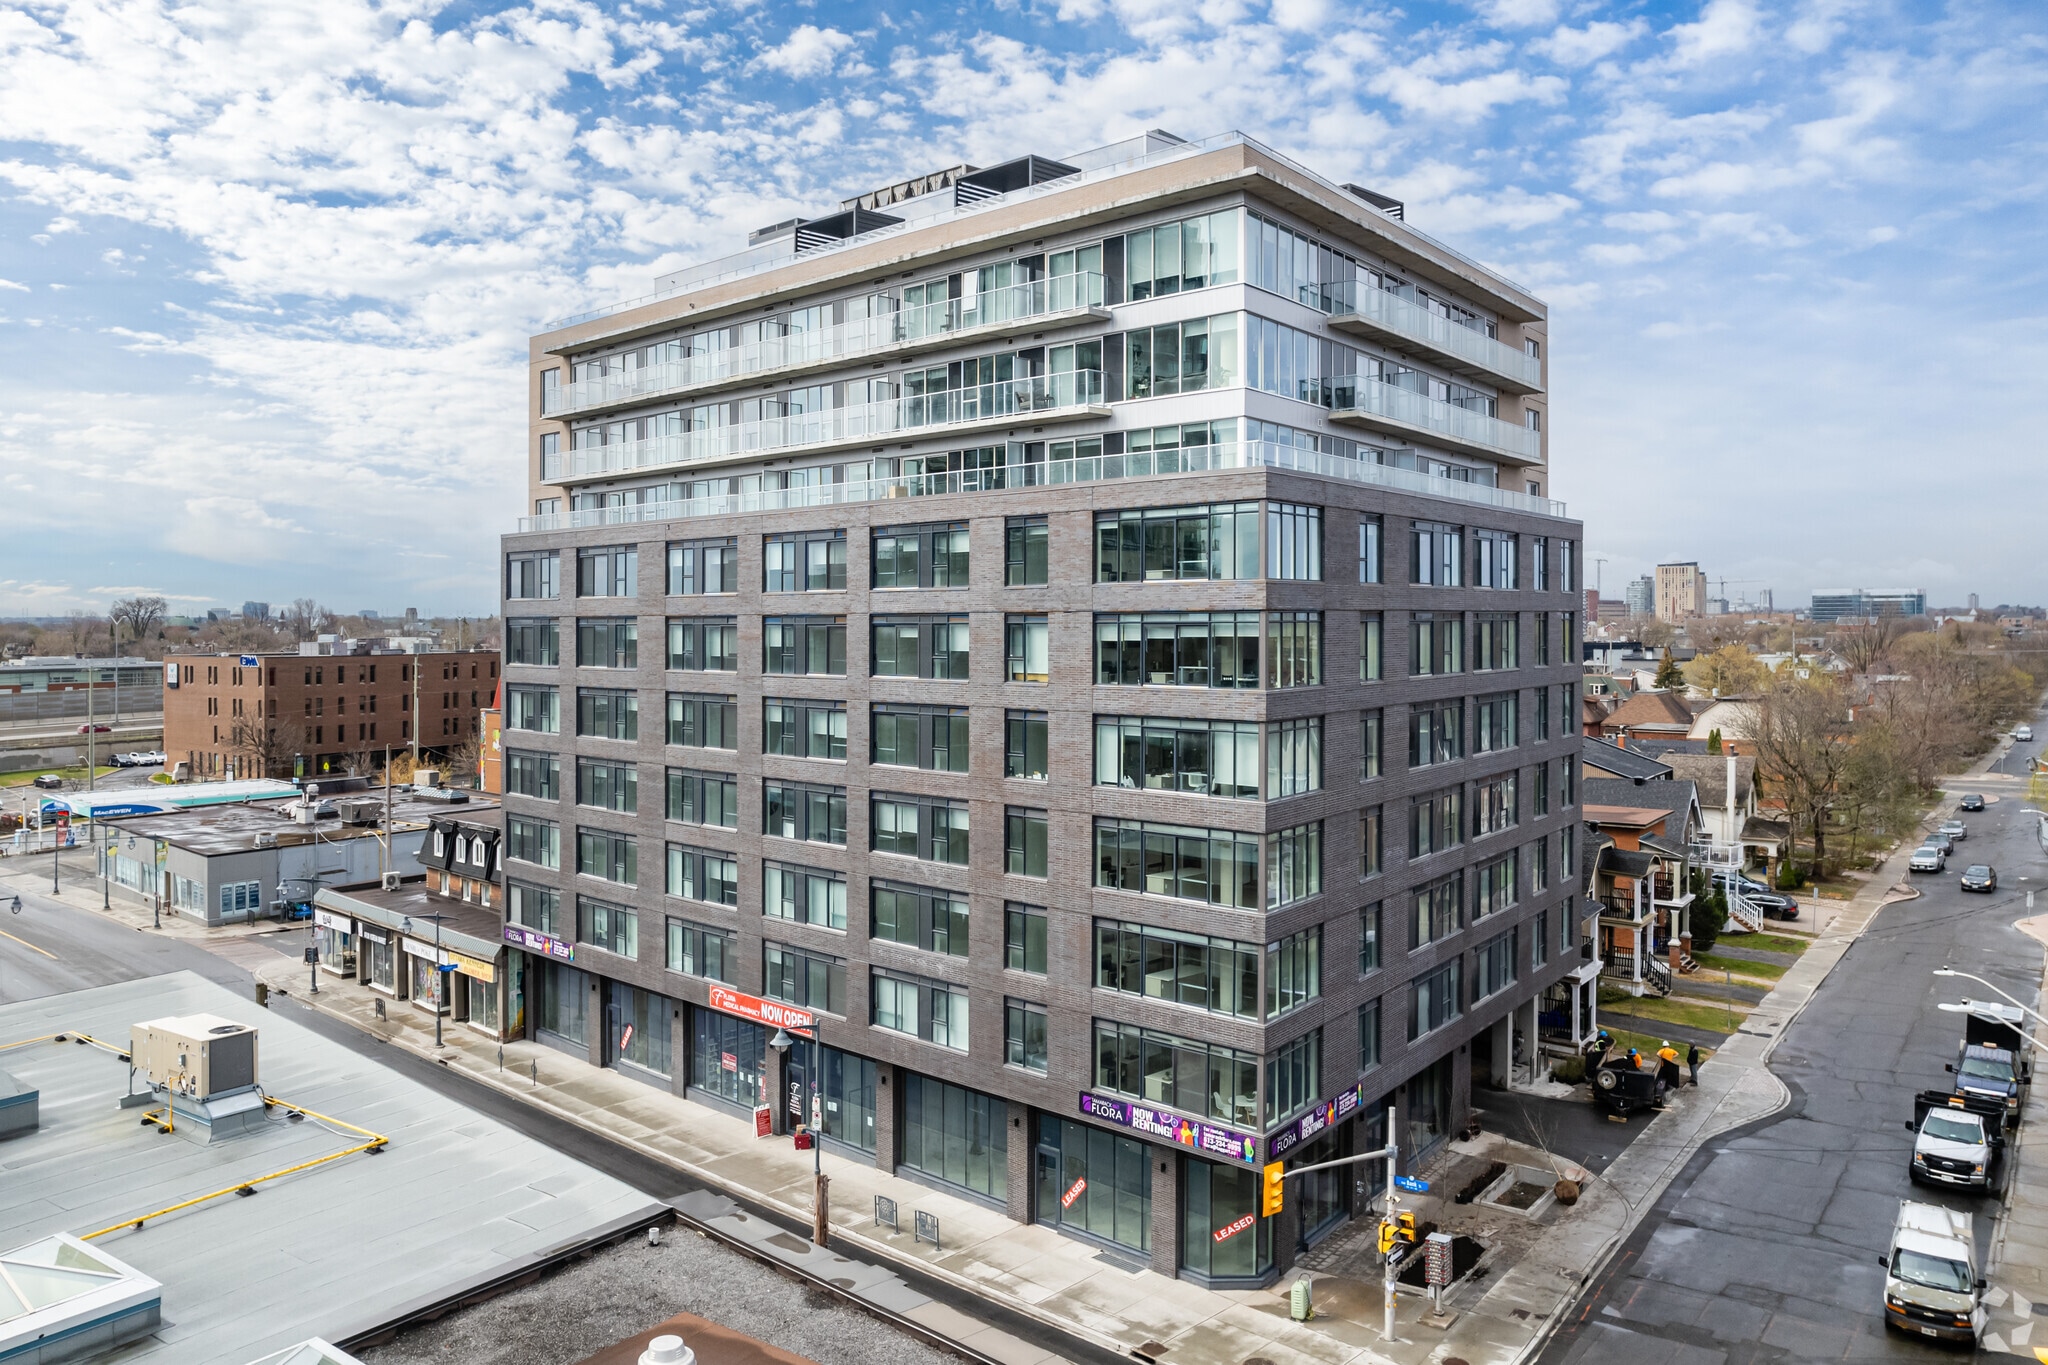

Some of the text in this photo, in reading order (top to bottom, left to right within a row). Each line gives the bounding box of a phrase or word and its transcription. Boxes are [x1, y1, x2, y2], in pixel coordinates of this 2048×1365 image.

[508, 932, 523, 943] FLORA
[761, 1003, 810, 1031] NOW OPEN
[620, 1025, 633, 1050] LEASED
[1091, 1103, 1123, 1121] FLORA
[1133, 1106, 1153, 1120] NOW
[1301, 1113, 1314, 1125] NOW
[1133, 1117, 1173, 1138] RENTING!
[1301, 1117, 1325, 1140] RENTING!
[1277, 1133, 1297, 1153] FLORA
[1062, 1179, 1086, 1208] LEASED
[1406, 1179, 1417, 1188] Bank
[1214, 1215, 1255, 1242] LEASED
